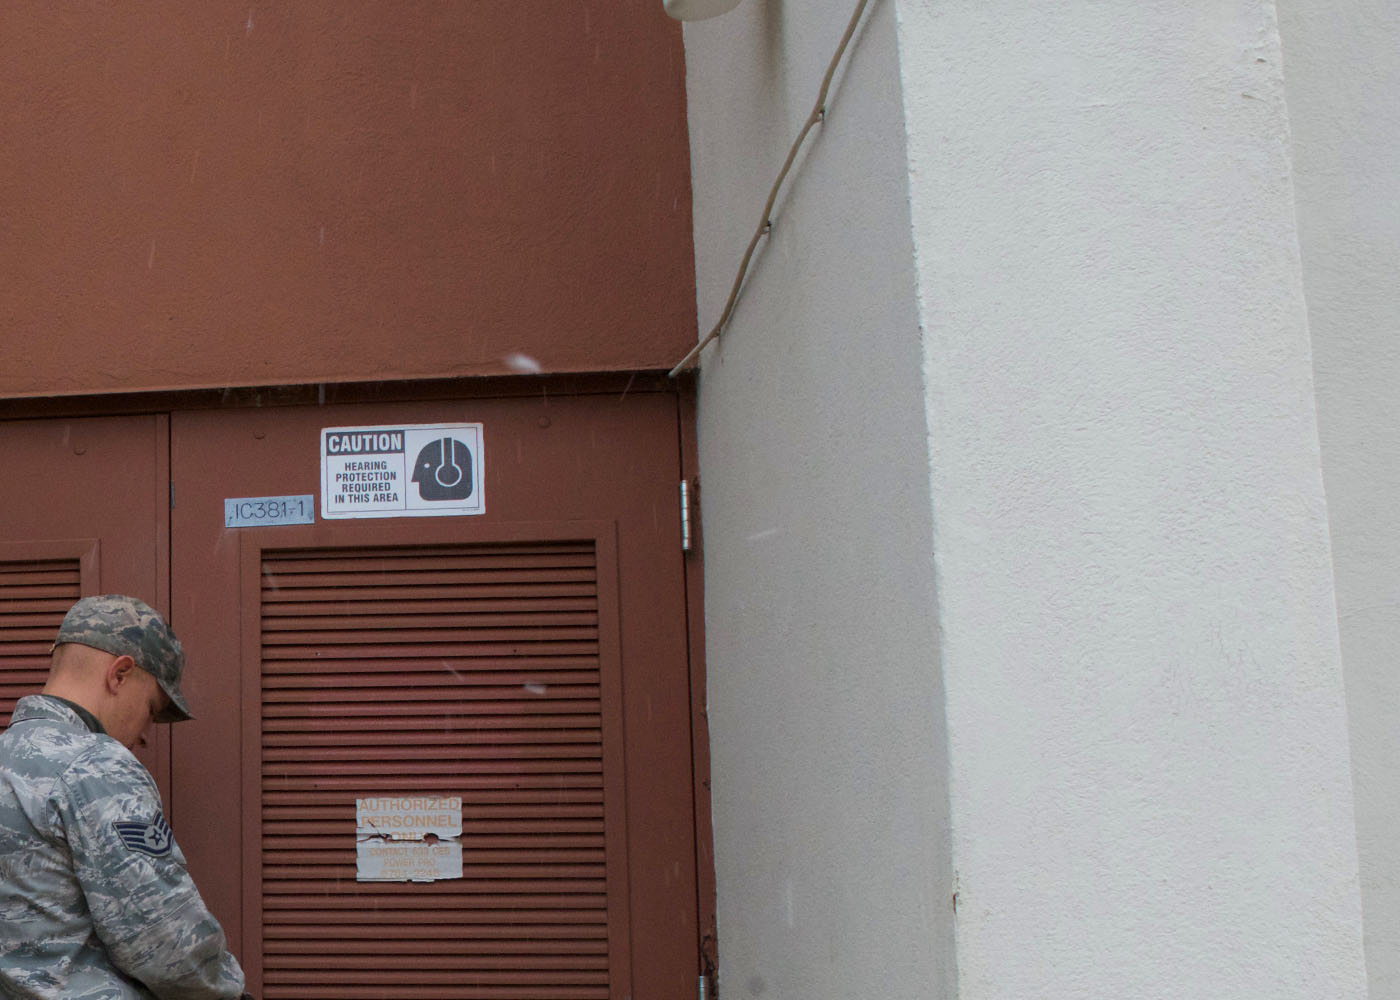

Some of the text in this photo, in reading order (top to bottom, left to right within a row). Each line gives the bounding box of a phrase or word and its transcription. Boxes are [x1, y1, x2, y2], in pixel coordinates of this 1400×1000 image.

[328, 433, 402, 453] CAUTION
[344, 461, 387, 471] HEARING
[335, 471, 397, 482] PROTECTION
[342, 482, 391, 493] REQUIRED
[334, 492, 399, 504] IN THIS AREA
[359, 798, 460, 811] AUTHORIZED
[361, 815, 457, 828] PERSONNEL
